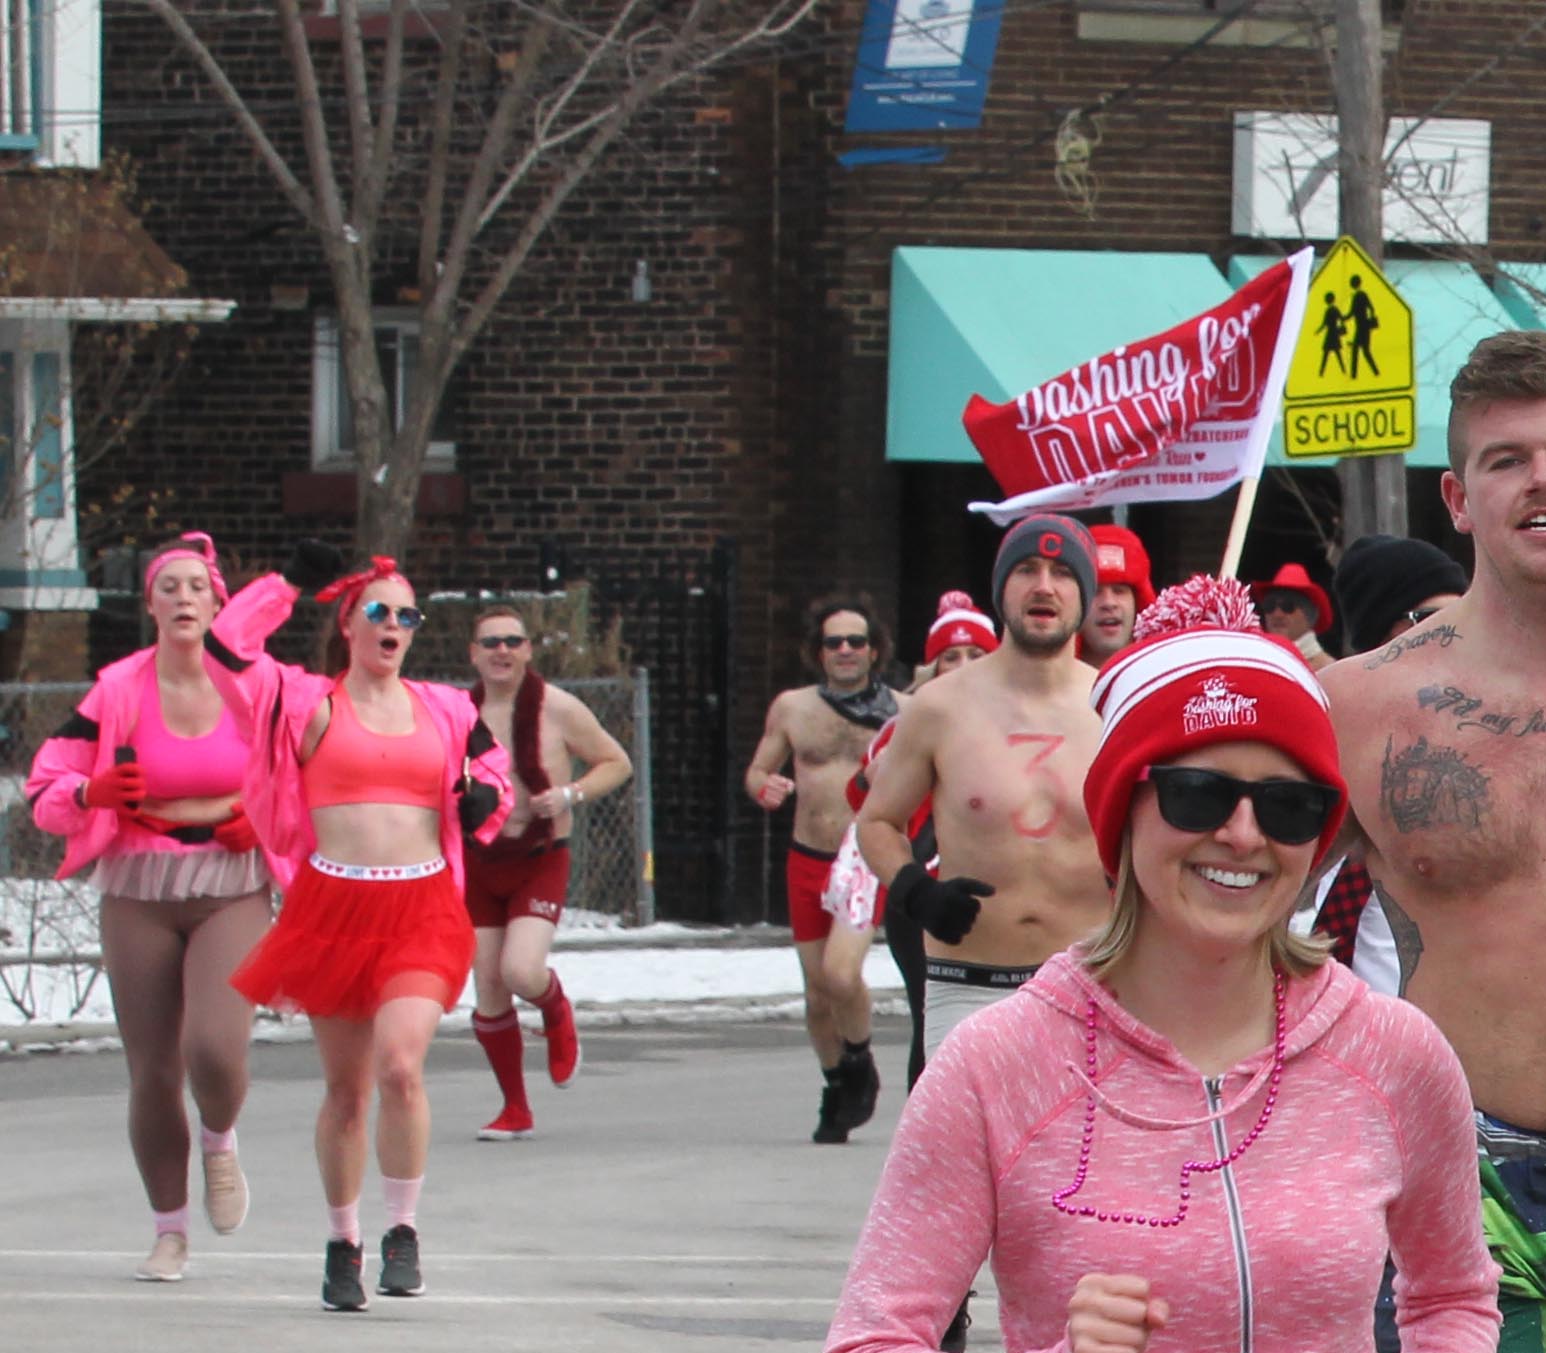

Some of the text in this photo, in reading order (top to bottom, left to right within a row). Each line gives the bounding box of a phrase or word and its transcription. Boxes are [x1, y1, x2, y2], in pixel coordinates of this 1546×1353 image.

[1016, 303, 1261, 430] Dashing for
[1295, 408, 1405, 446] SCHOOL
[1039, 533, 1063, 557] C
[1183, 694, 1258, 717] Dashing for
[1183, 706, 1257, 735] DAVID
[1006, 732, 1066, 839] 3
